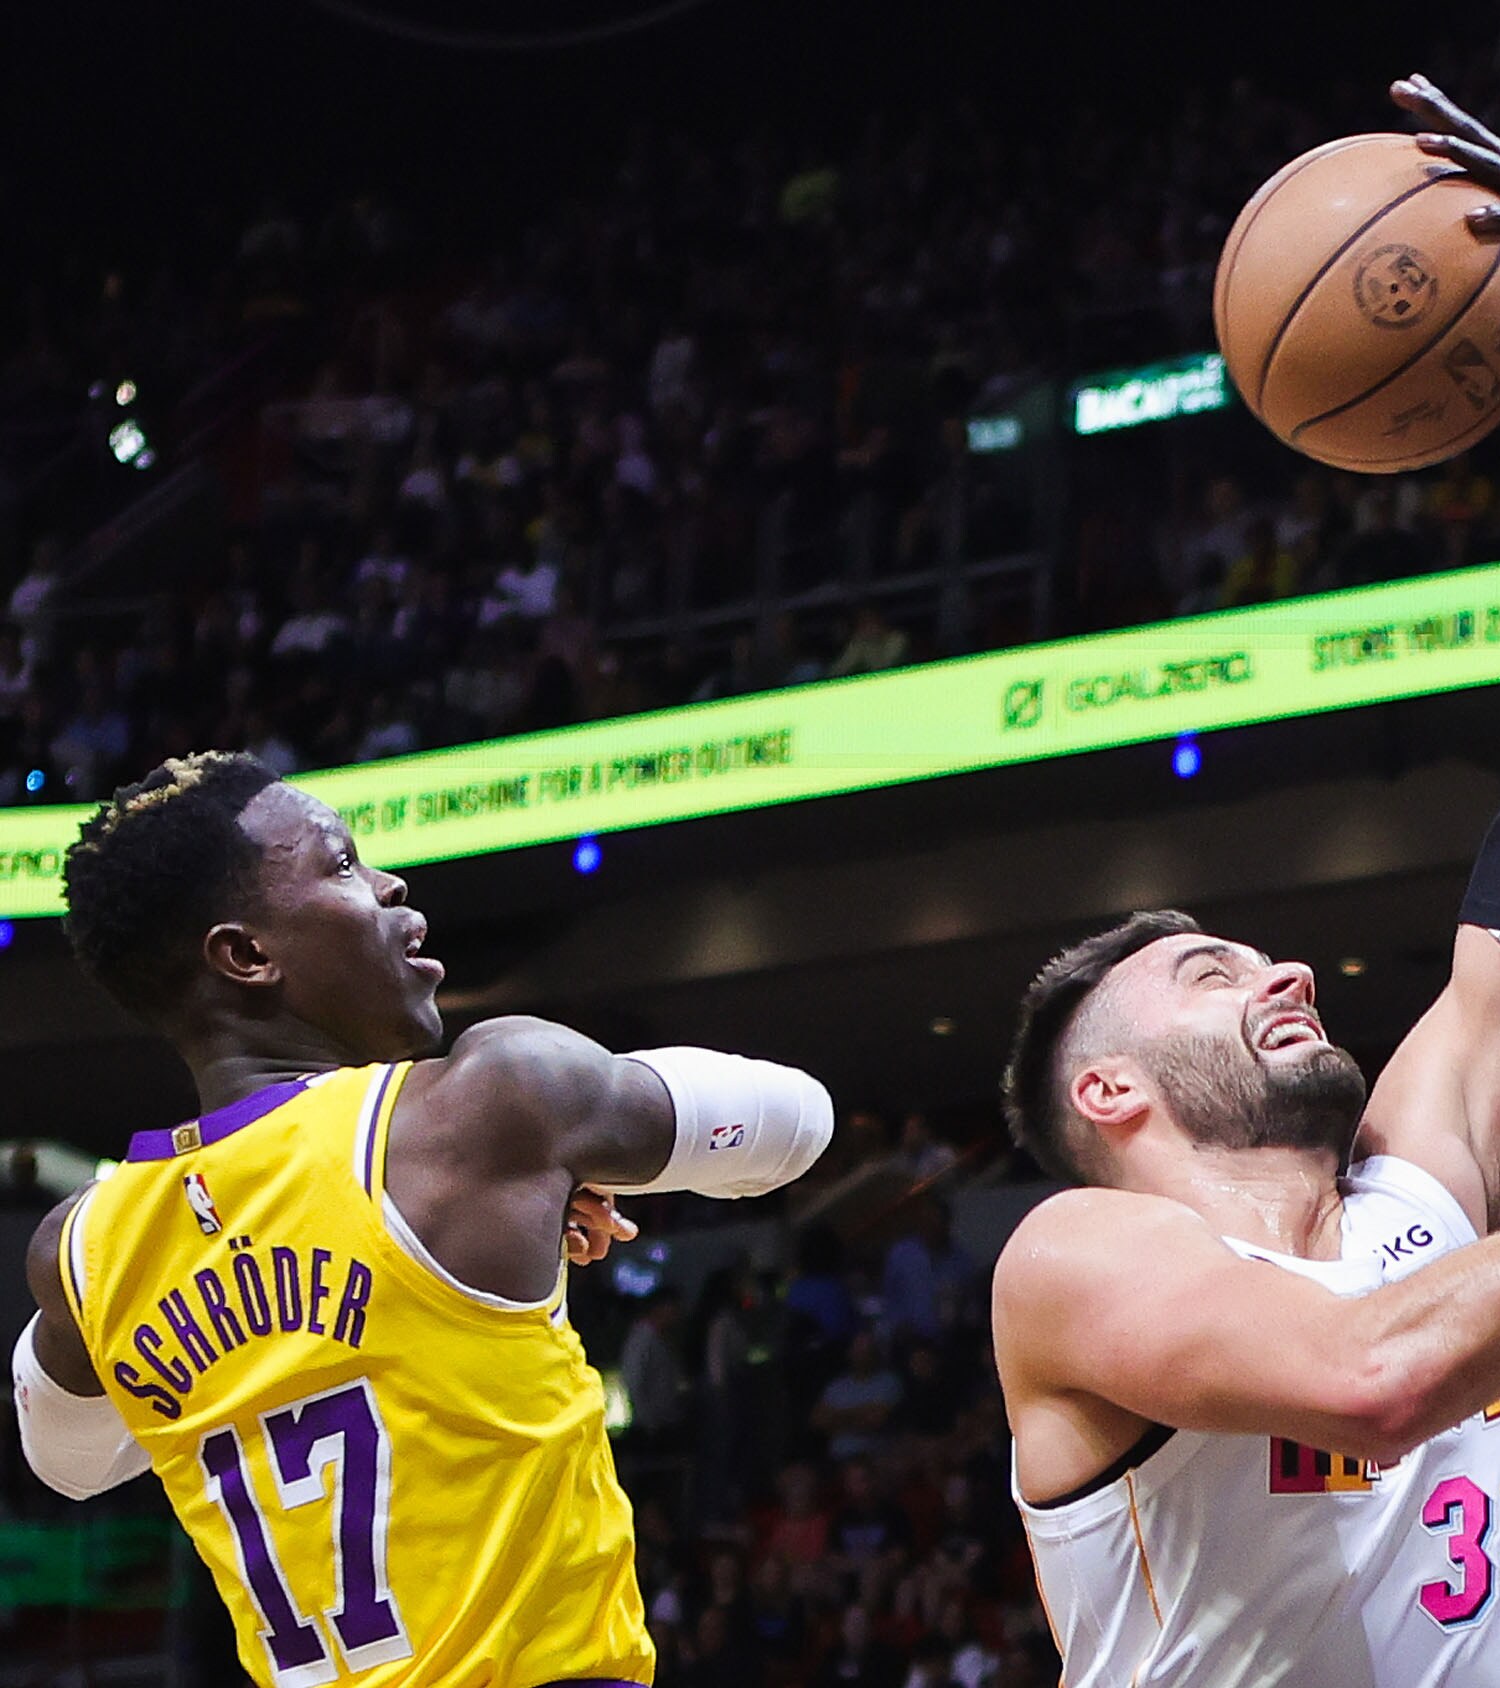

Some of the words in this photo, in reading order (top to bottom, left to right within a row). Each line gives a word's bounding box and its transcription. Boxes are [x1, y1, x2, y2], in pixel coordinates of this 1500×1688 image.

[1312, 624, 1397, 672] STORE
[381, 793, 410, 833] OF
[416, 775, 531, 826] SUNSHINE
[608, 746, 695, 787] POWER
[700, 728, 794, 776] OUTAGE
[1373, 1224, 1433, 1270] KG
[114, 1236, 373, 1420] SCHRÖDER
[199, 1376, 416, 1688] 17
